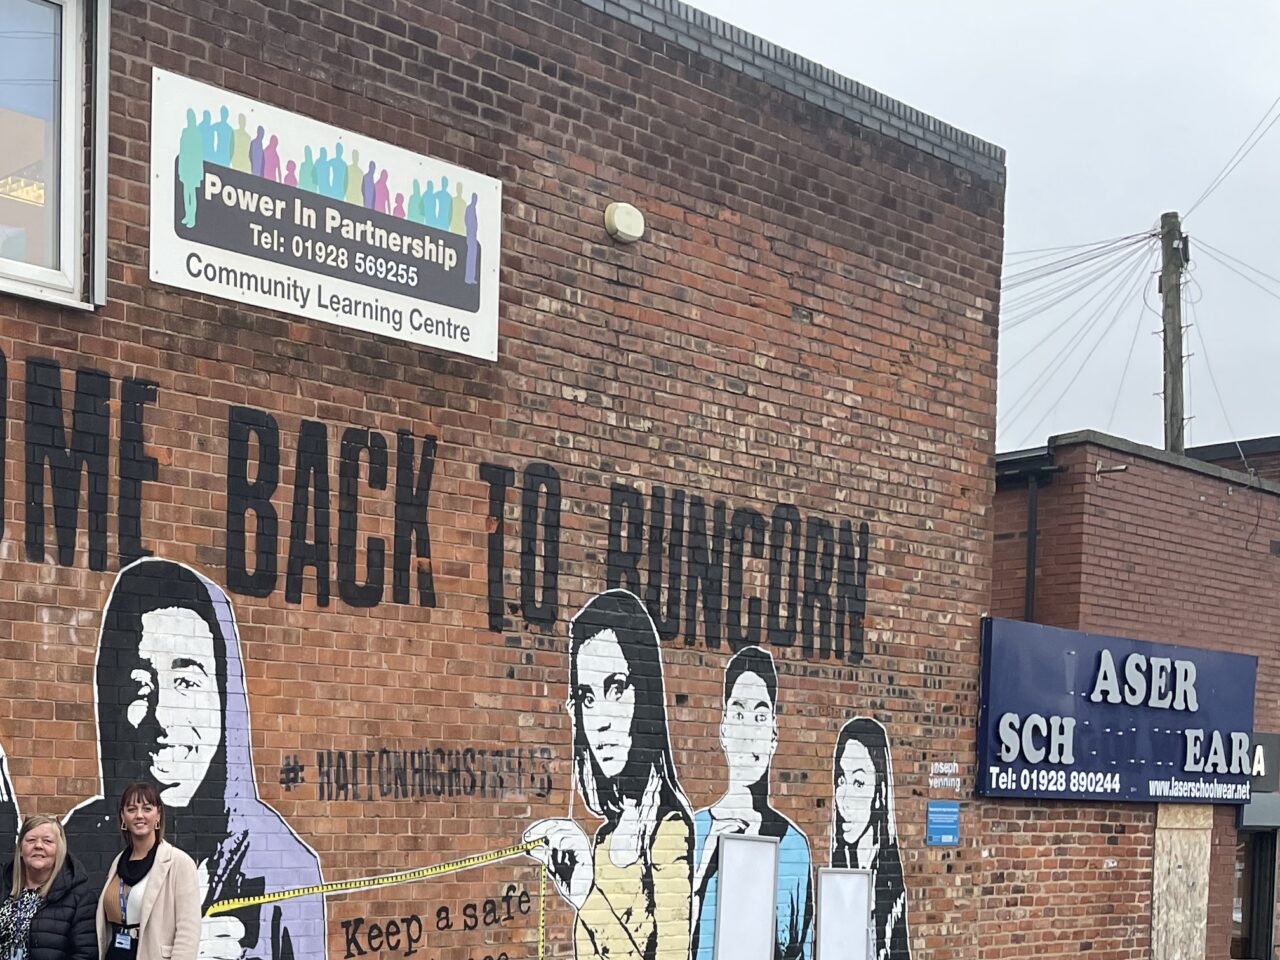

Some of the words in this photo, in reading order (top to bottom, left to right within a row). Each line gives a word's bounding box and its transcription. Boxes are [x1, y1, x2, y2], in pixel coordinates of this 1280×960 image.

[204, 172, 286, 220] Power
[295, 199, 317, 229] In
[325, 206, 458, 272] Partnership
[249, 223, 284, 253] Tel:
[292, 235, 348, 270] 01928
[355, 252, 418, 287] 569255
[186, 251, 310, 308] Community
[317, 284, 402, 332] Learning
[410, 307, 471, 343] Centre
[226, 406, 437, 608] BACK
[480, 462, 561, 633] TO
[607, 482, 869, 664] RUNCORN
[1091, 649, 1199, 711] ASER
[999, 712, 1076, 764] SCH
[1184, 728, 1251, 775] EAR
[989, 766, 1016, 790] Tel:
[1020, 769, 1066, 792] 01928
[1070, 771, 1120, 793] 890244
[1149, 776, 1250, 800] www.laserschoolwear.net
[341, 914, 423, 959] Keep
[436, 905, 453, 931] a
[463, 884, 531, 931] safe
